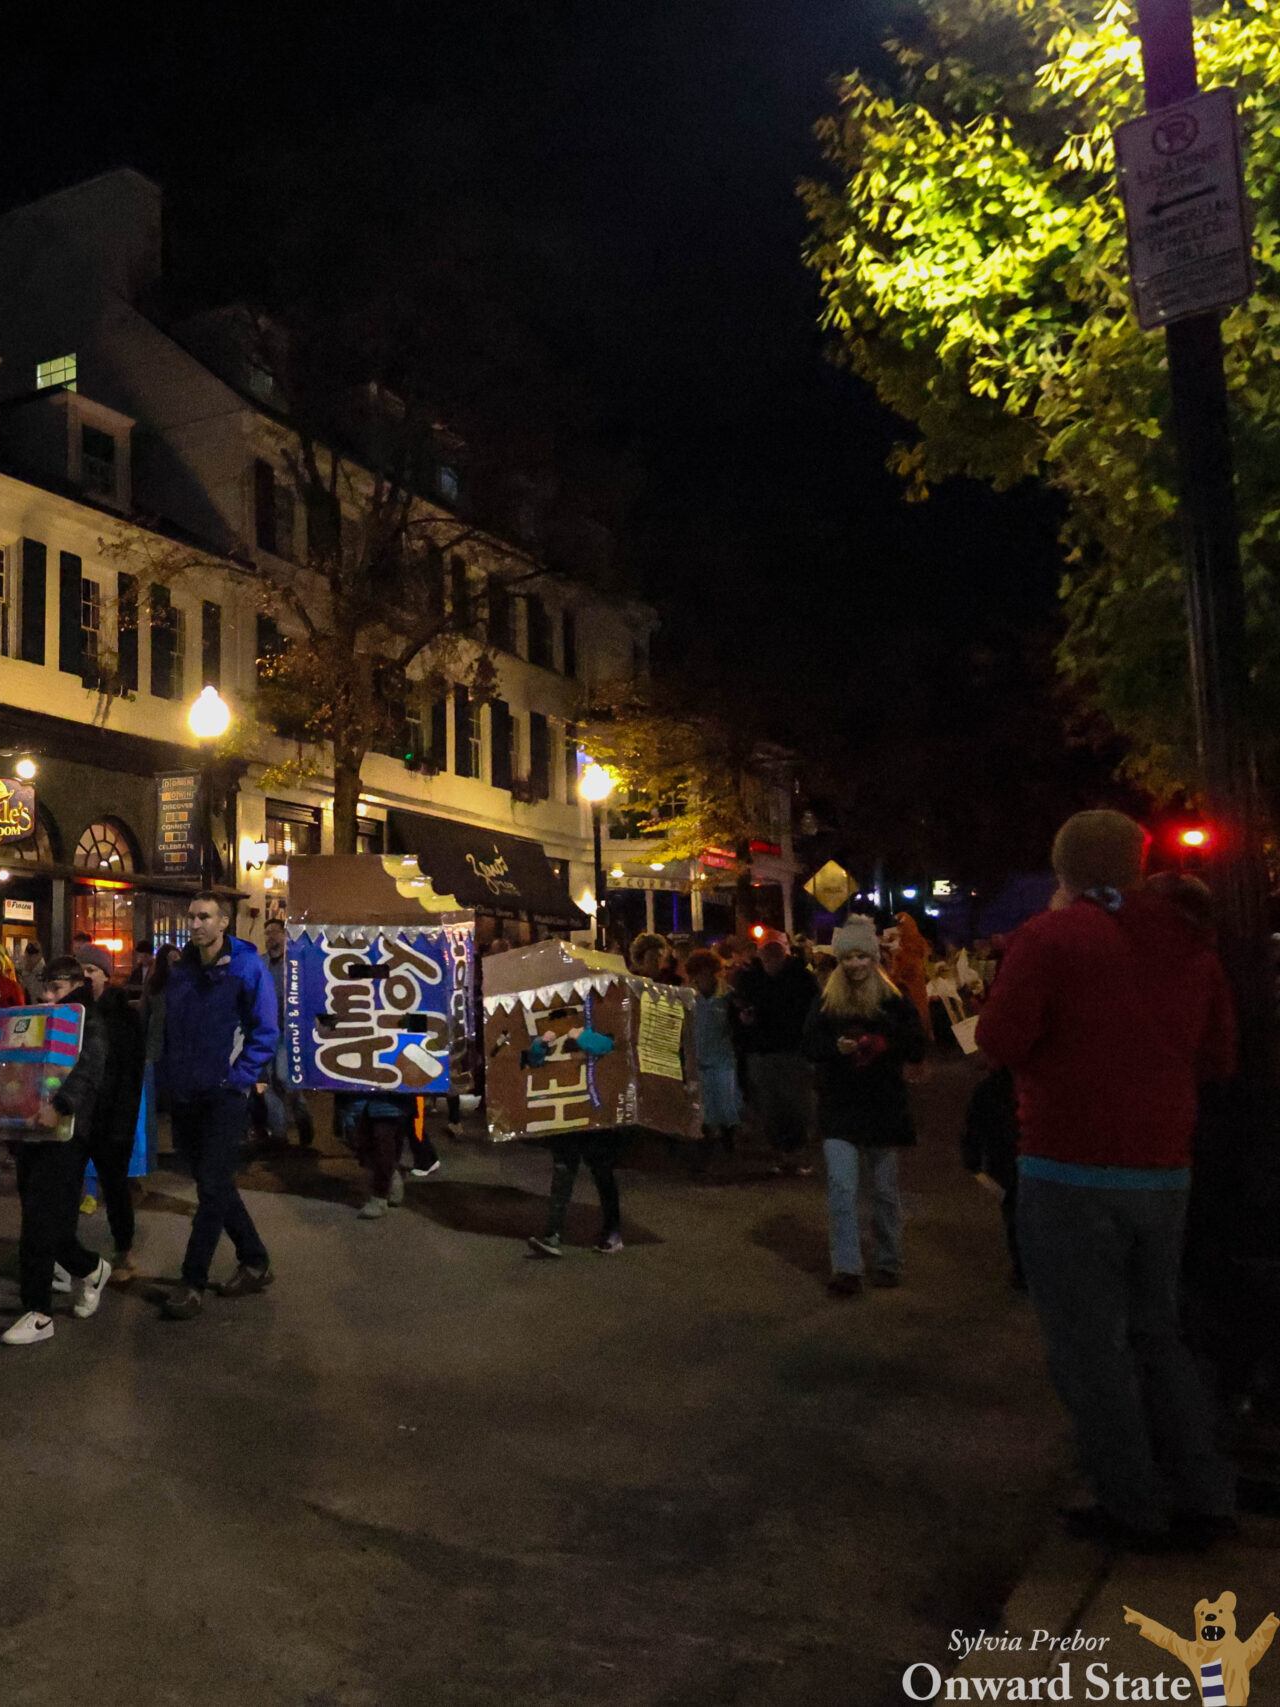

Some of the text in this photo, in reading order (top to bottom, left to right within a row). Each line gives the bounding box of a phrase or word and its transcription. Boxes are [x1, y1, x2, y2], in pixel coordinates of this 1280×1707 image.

[161, 823, 192, 831] CONNECT
[288, 959, 303, 1084] Coconut & Almond
